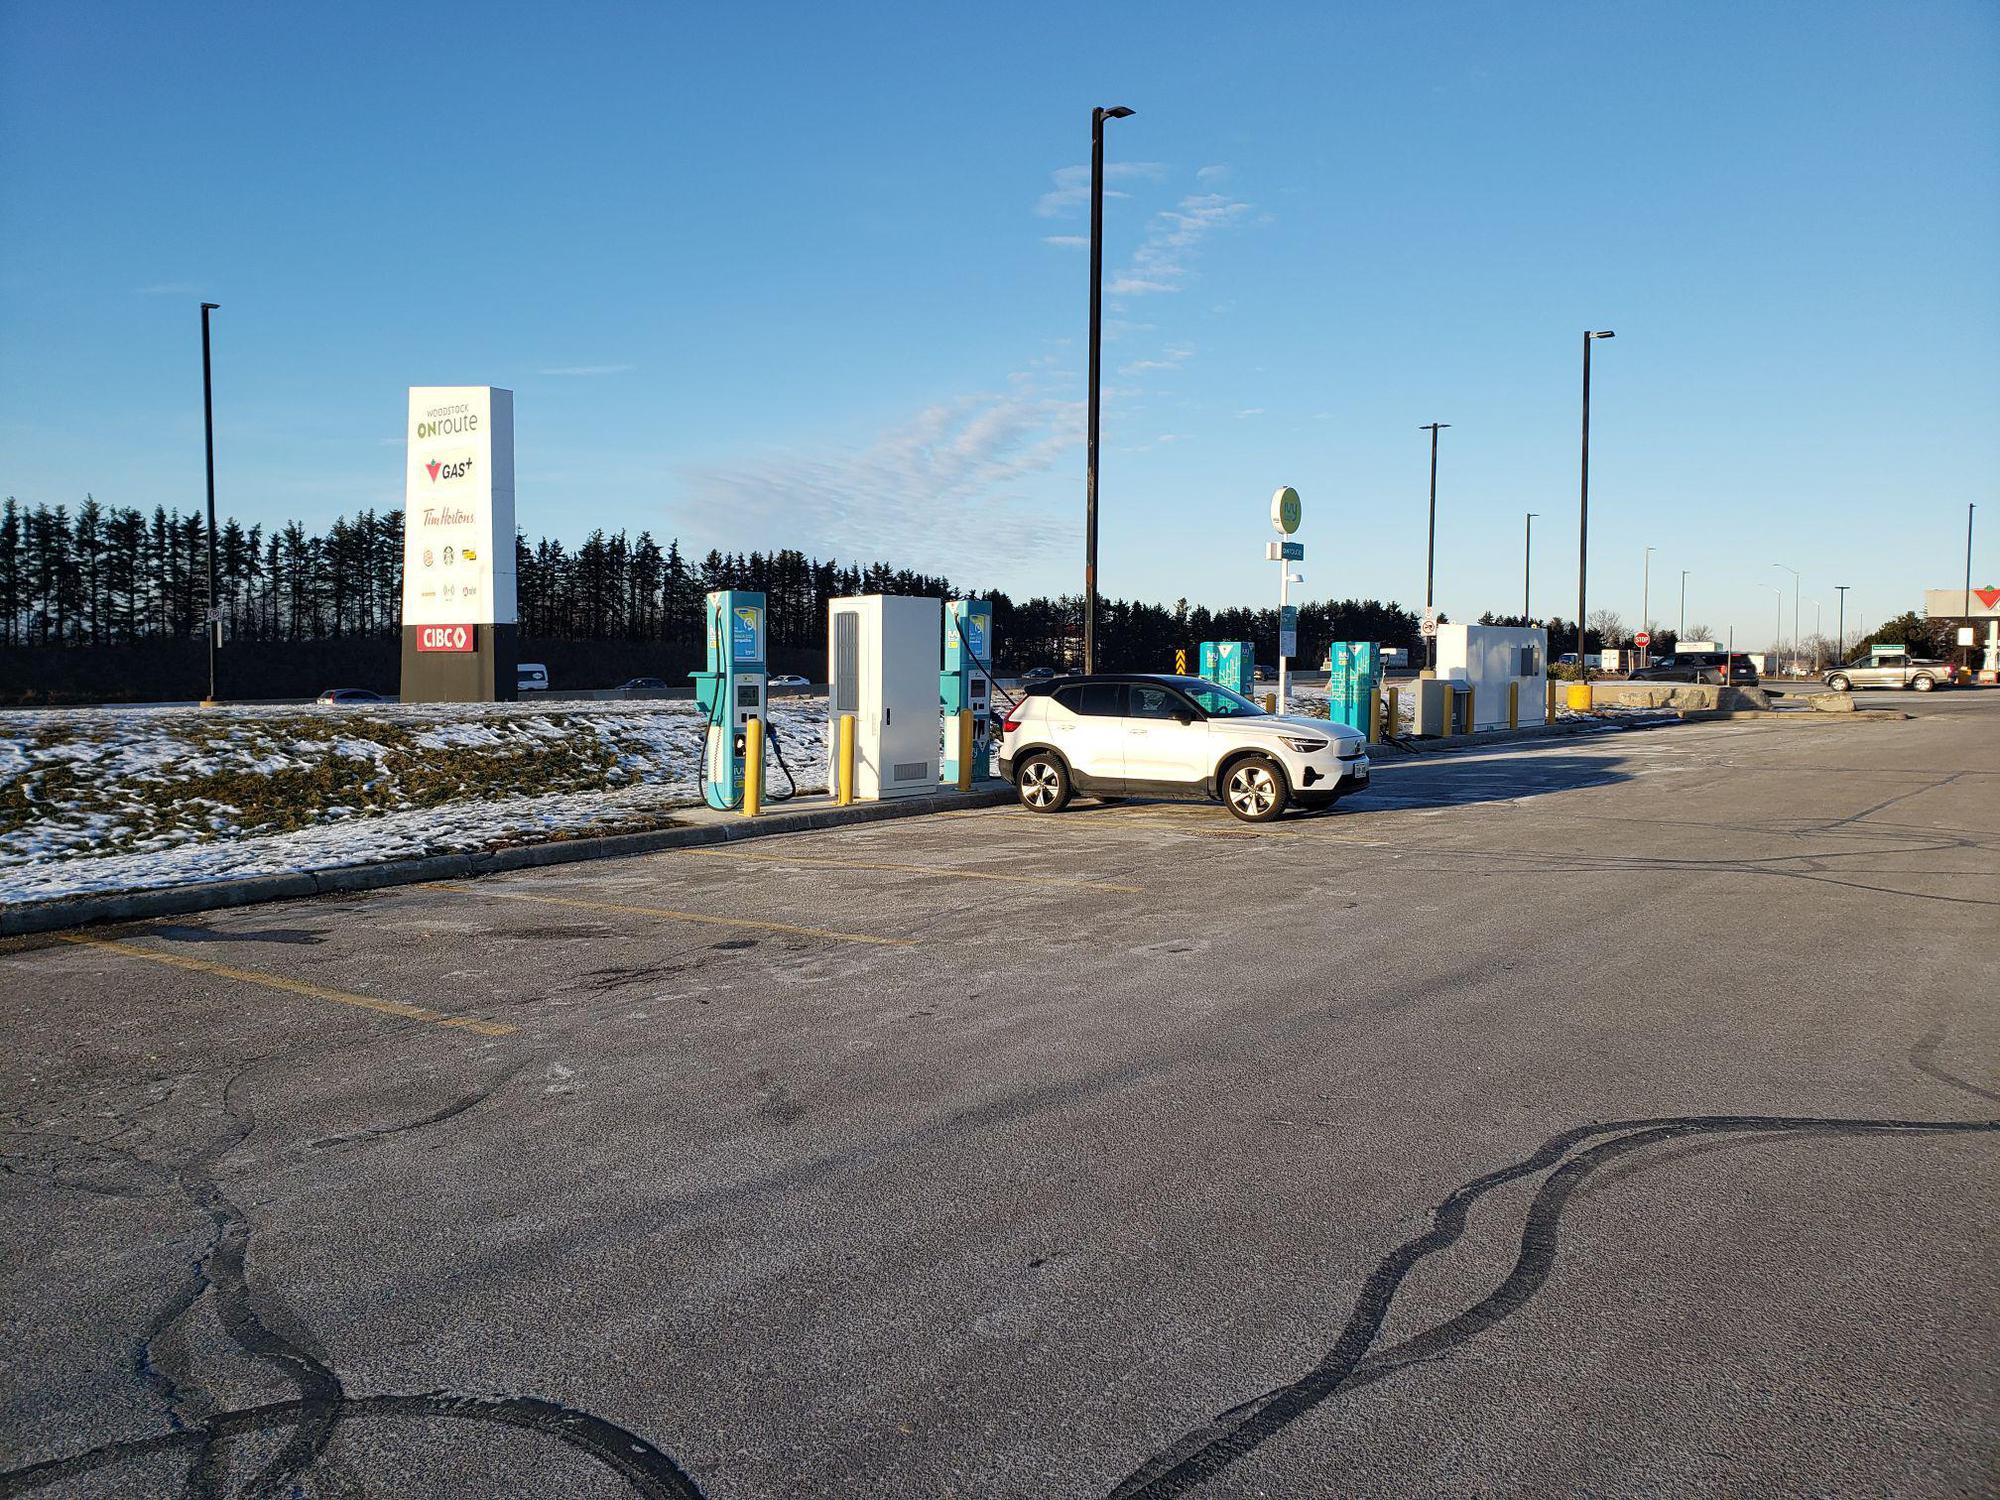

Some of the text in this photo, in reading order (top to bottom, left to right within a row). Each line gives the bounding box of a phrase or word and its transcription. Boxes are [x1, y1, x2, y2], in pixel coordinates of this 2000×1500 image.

[426, 404, 469, 418] WOODSTOCK
[417, 414, 478, 439] ONroute
[423, 506, 474, 526] Tim Hortons
[423, 628, 453, 648] CIBC
[1206, 649, 1219, 662] ivy
